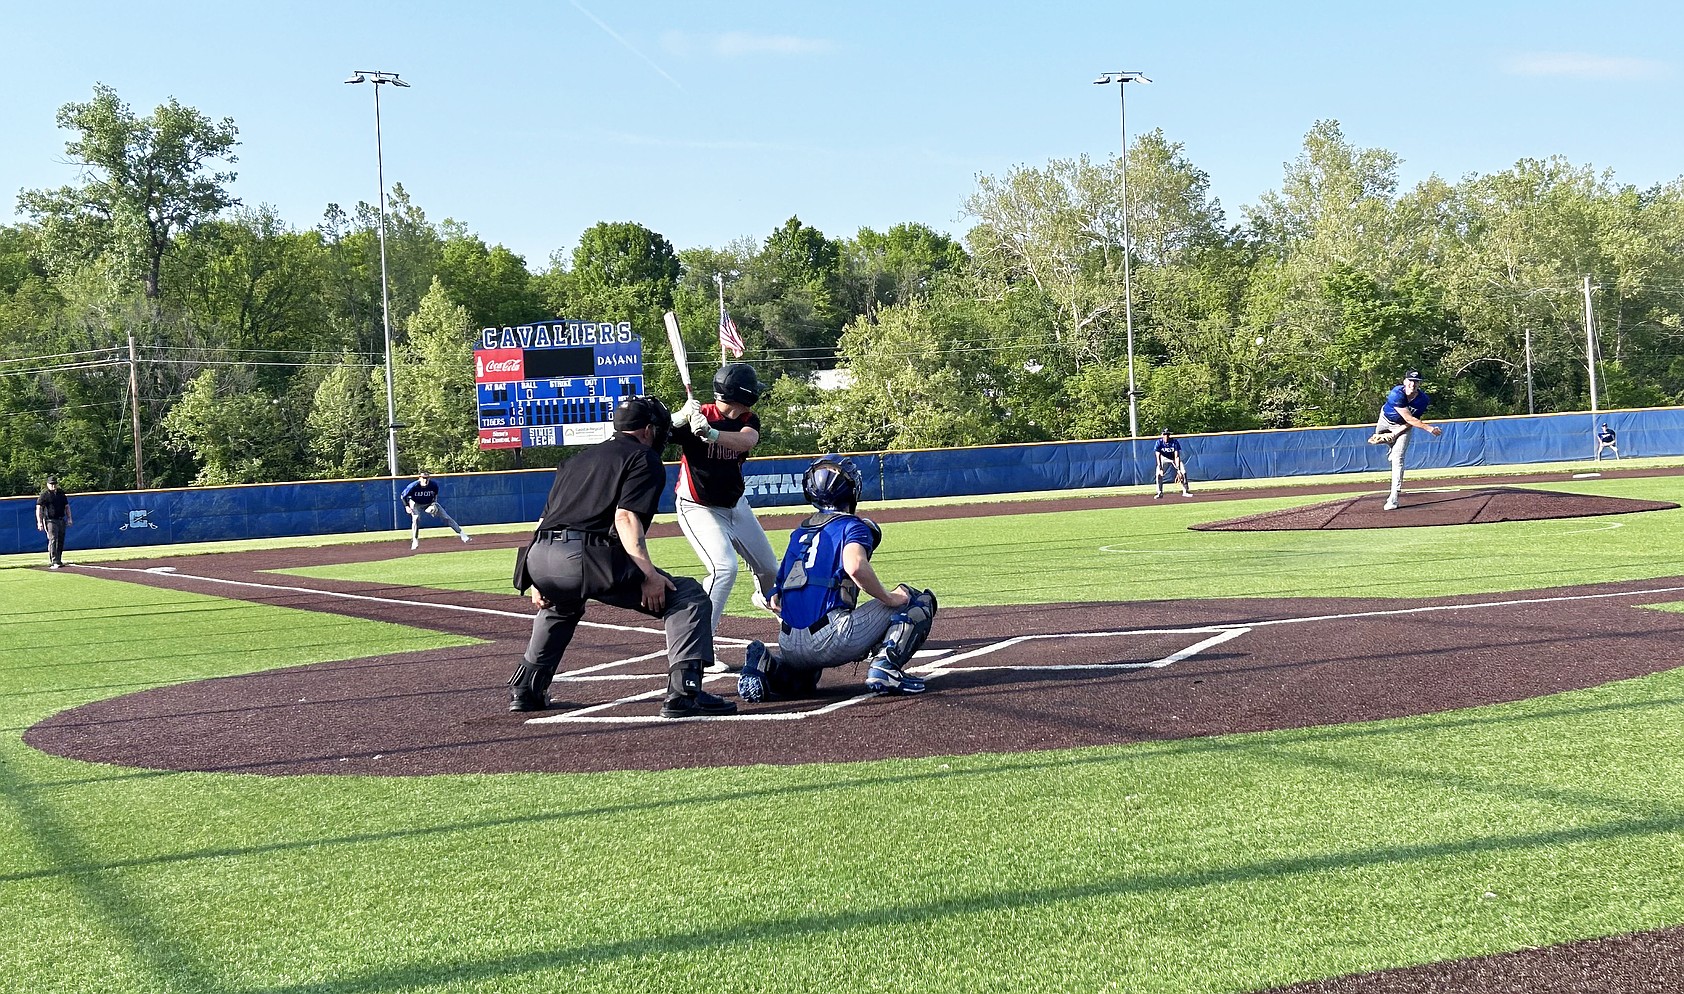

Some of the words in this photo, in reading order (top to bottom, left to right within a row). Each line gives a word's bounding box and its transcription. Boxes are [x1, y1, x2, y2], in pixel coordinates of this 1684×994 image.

[482, 322, 632, 349] CAVALIERS
[597, 354, 637, 366] DASANI
[494, 383, 506, 391] BAT
[550, 379, 572, 388] STRIKE
[526, 389, 533, 399] 0
[589, 386, 595, 396] 3
[518, 407, 524, 415] 2
[607, 402, 614, 411] 3
[482, 418, 505, 427] TIGERS
[510, 417, 516, 426] 0
[518, 416, 524, 425] 0
[530, 428, 553, 437] STATE
[530, 436, 556, 446] TECH
[798, 532, 820, 568] 3
